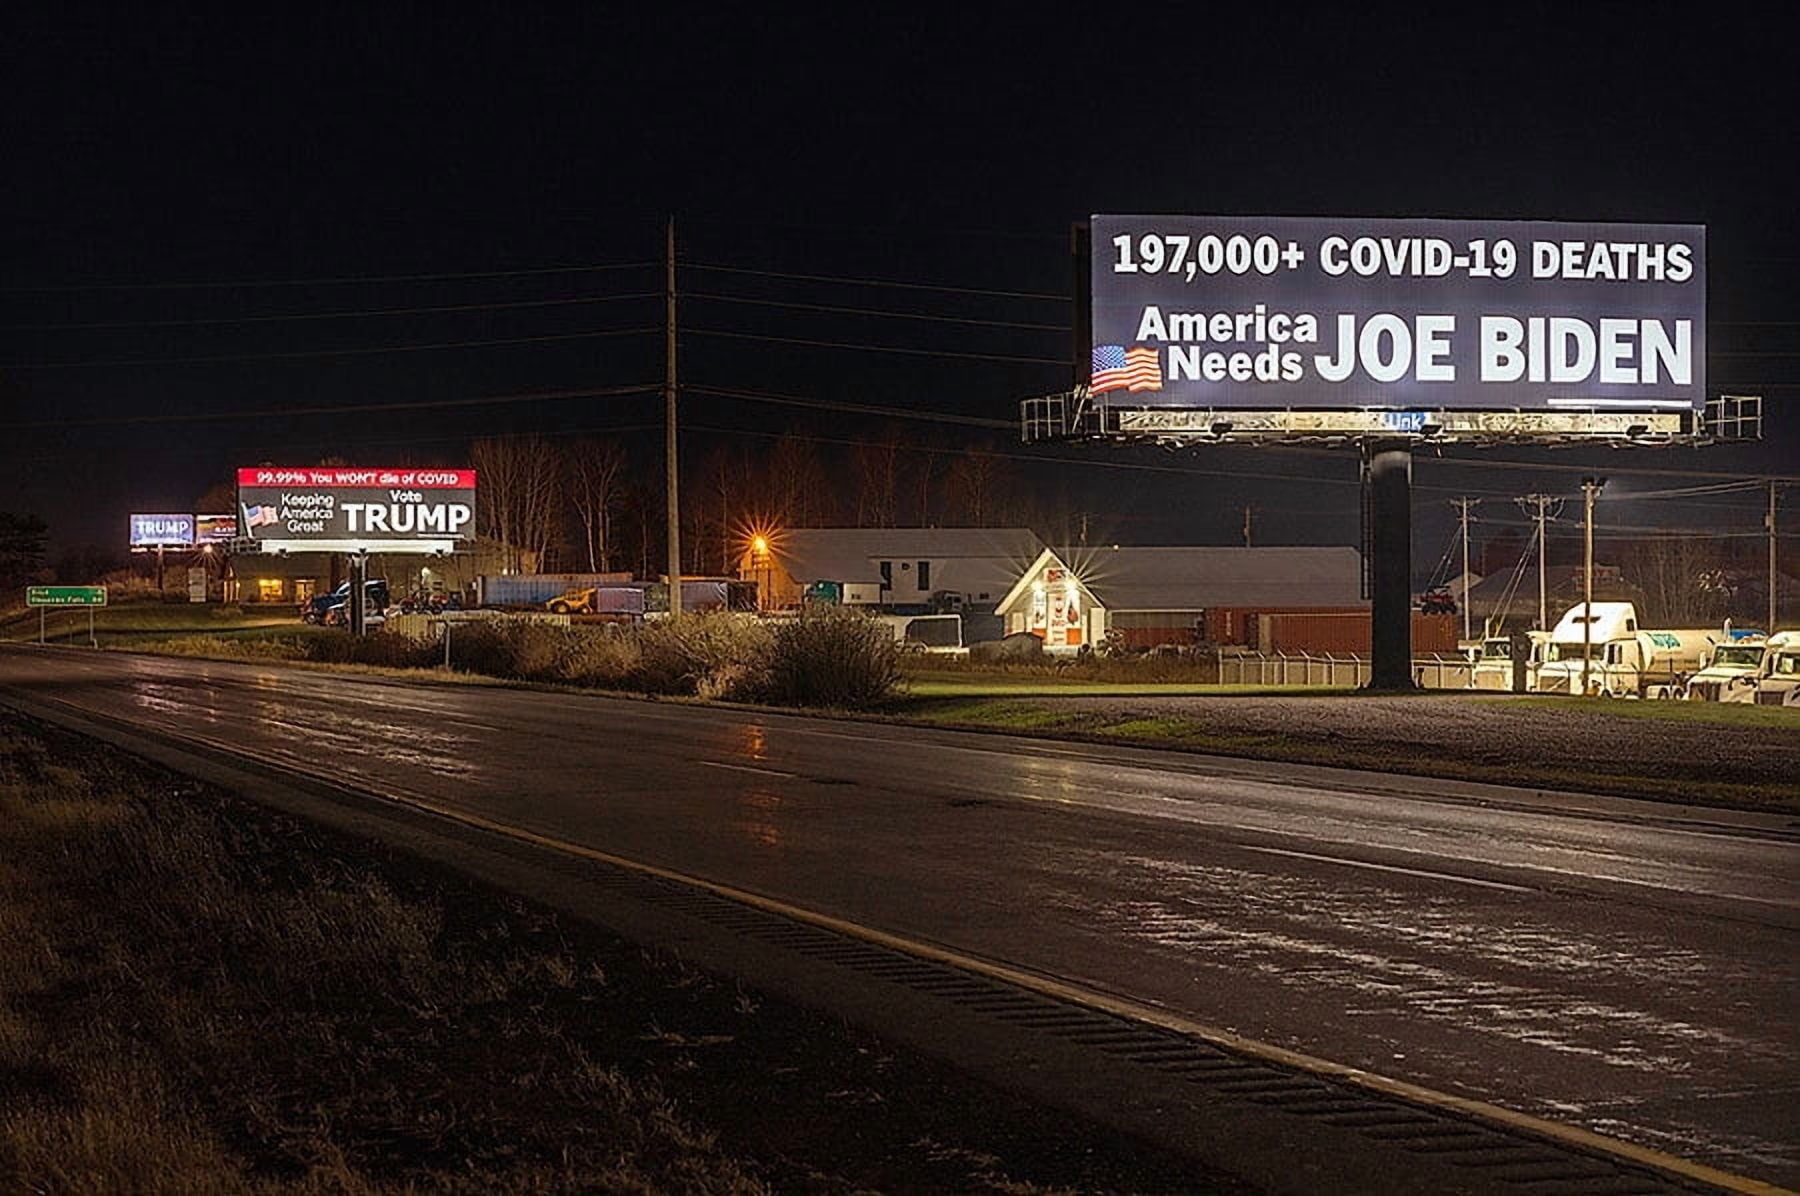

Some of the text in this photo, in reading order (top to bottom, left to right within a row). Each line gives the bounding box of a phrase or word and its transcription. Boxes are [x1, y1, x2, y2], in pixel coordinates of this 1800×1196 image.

[1113, 234, 1693, 283] 197,000+ COVID-19 DEATHS
[1136, 304, 1318, 343] America
[1314, 313, 1692, 385] JOE BIDEN
[1168, 344, 1304, 382] Needs
[257, 472, 307, 484] 99.99%
[310, 473, 333, 484] You
[379, 473, 399, 484] die
[402, 473, 415, 484] of
[417, 473, 459, 485] COVID
[281, 493, 335, 508] Keeping
[389, 490, 423, 503] Vote
[280, 507, 334, 519] America
[340, 503, 471, 533] TRUMP
[136, 520, 189, 535] TRUMP
[287, 520, 324, 532] Great
